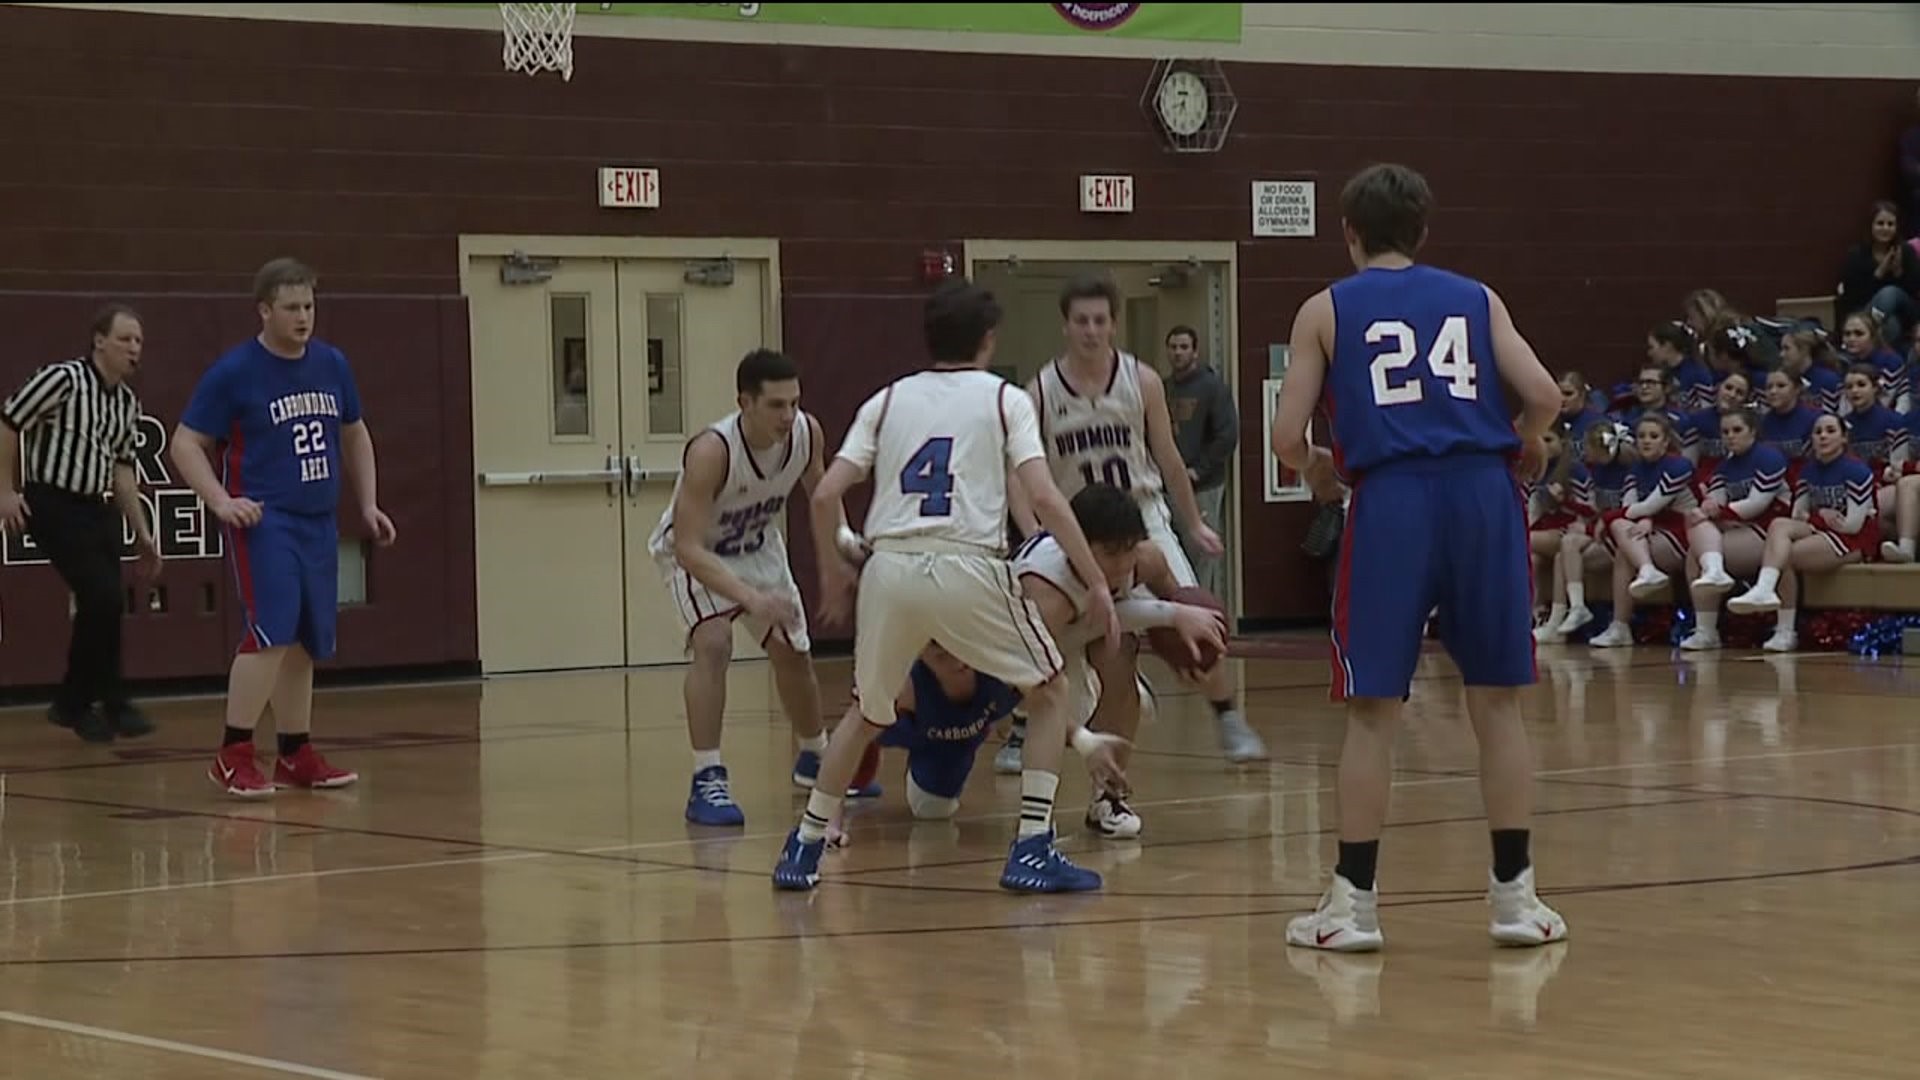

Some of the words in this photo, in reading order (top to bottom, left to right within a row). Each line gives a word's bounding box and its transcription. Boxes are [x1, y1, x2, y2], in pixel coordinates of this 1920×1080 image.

[615, 170, 650, 203] EXIT
[1095, 178, 1125, 207] EXIT
[1260, 196, 1273, 205] OR
[1275, 195, 1307, 205] DRINKS
[1264, 184, 1277, 194] NO
[1279, 184, 1303, 194] FOOD
[1258, 206, 1300, 216] ALLOWED
[1365, 316, 1477, 405] 24
[293, 421, 326, 455] 22
[301, 456, 329, 482] AREA
[900, 437, 954, 516] 4
[1079, 457, 1132, 491] 10
